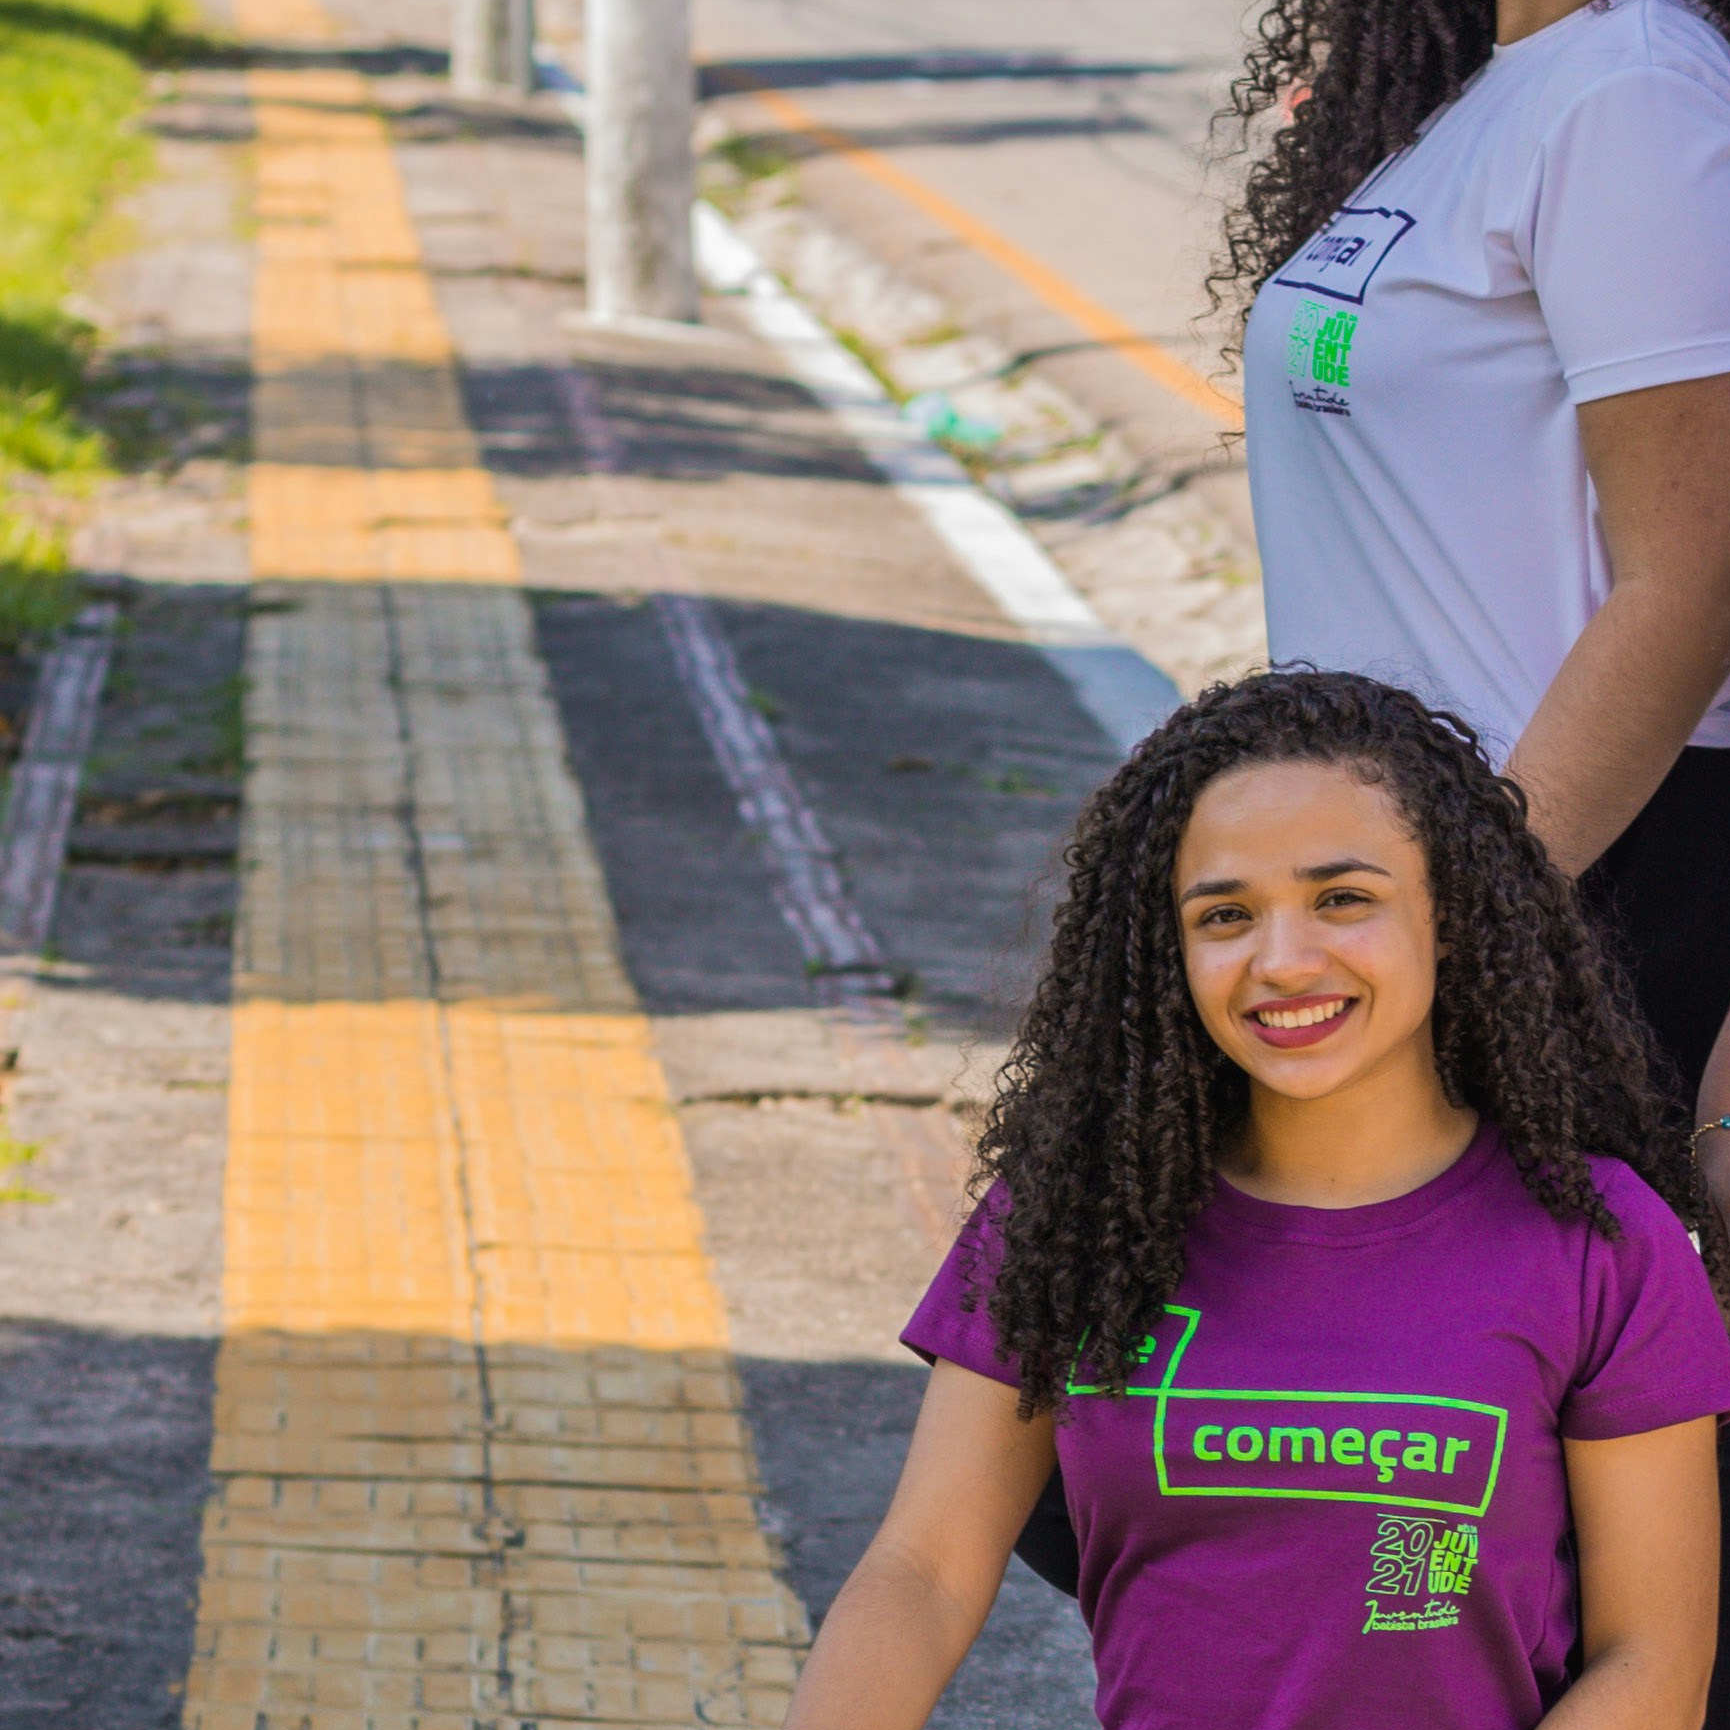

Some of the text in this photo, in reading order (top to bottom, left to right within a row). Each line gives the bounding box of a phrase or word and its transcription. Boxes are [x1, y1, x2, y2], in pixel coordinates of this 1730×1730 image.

[1192, 1423, 1472, 1484] começar
[1369, 1518, 1435, 1560] 20
[1432, 1528, 1480, 1559] JUV
[1365, 1555, 1426, 1597] 21
[1428, 1549, 1479, 1577] ENT
[1427, 1571, 1473, 1596] UDE
